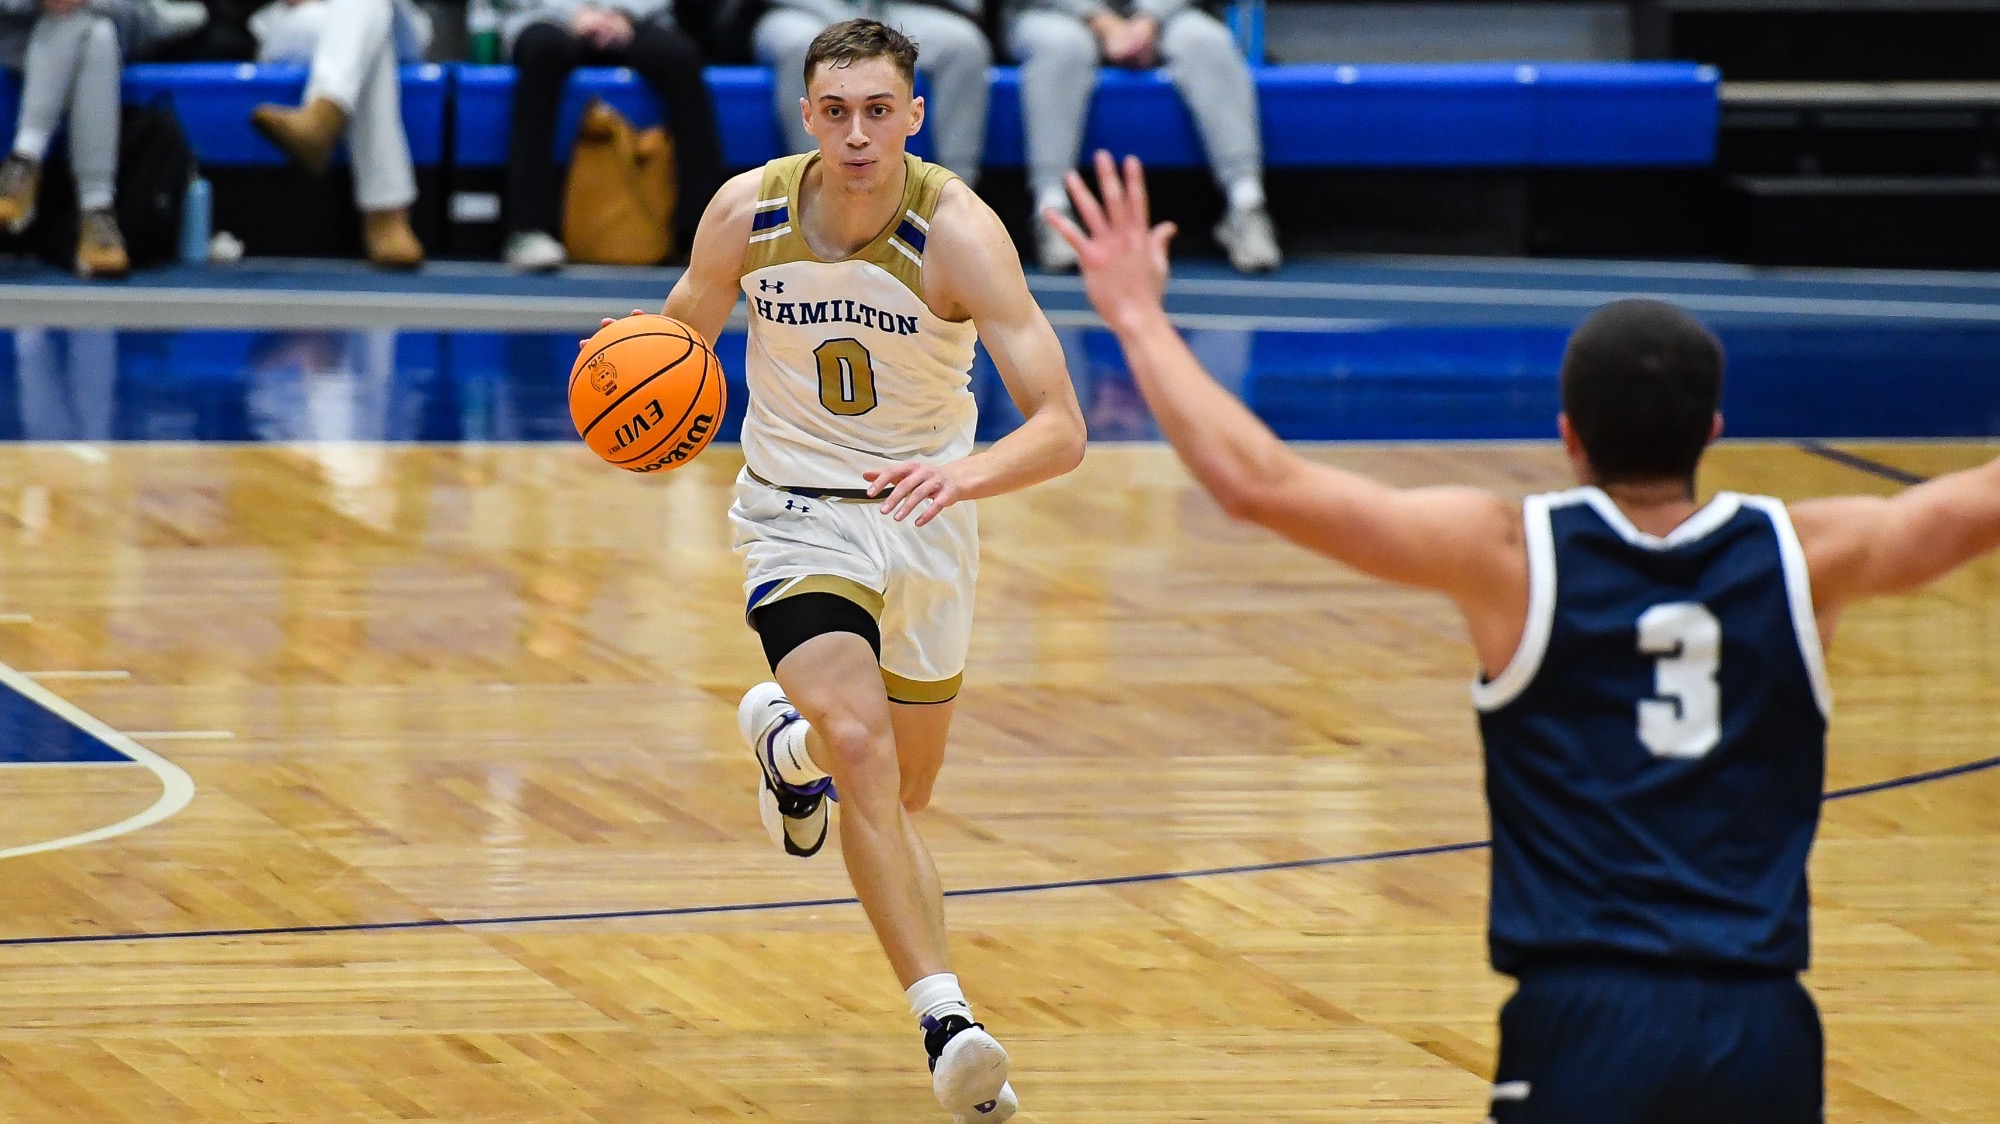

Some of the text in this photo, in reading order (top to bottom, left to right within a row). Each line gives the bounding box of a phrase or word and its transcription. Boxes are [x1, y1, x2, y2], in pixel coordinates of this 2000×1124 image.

[754, 295, 919, 336] HAMILTON
[812, 337, 878, 416] 0
[614, 399, 665, 448] EVO
[626, 413, 714, 473] Wilson
[1634, 601, 1723, 759] 3
